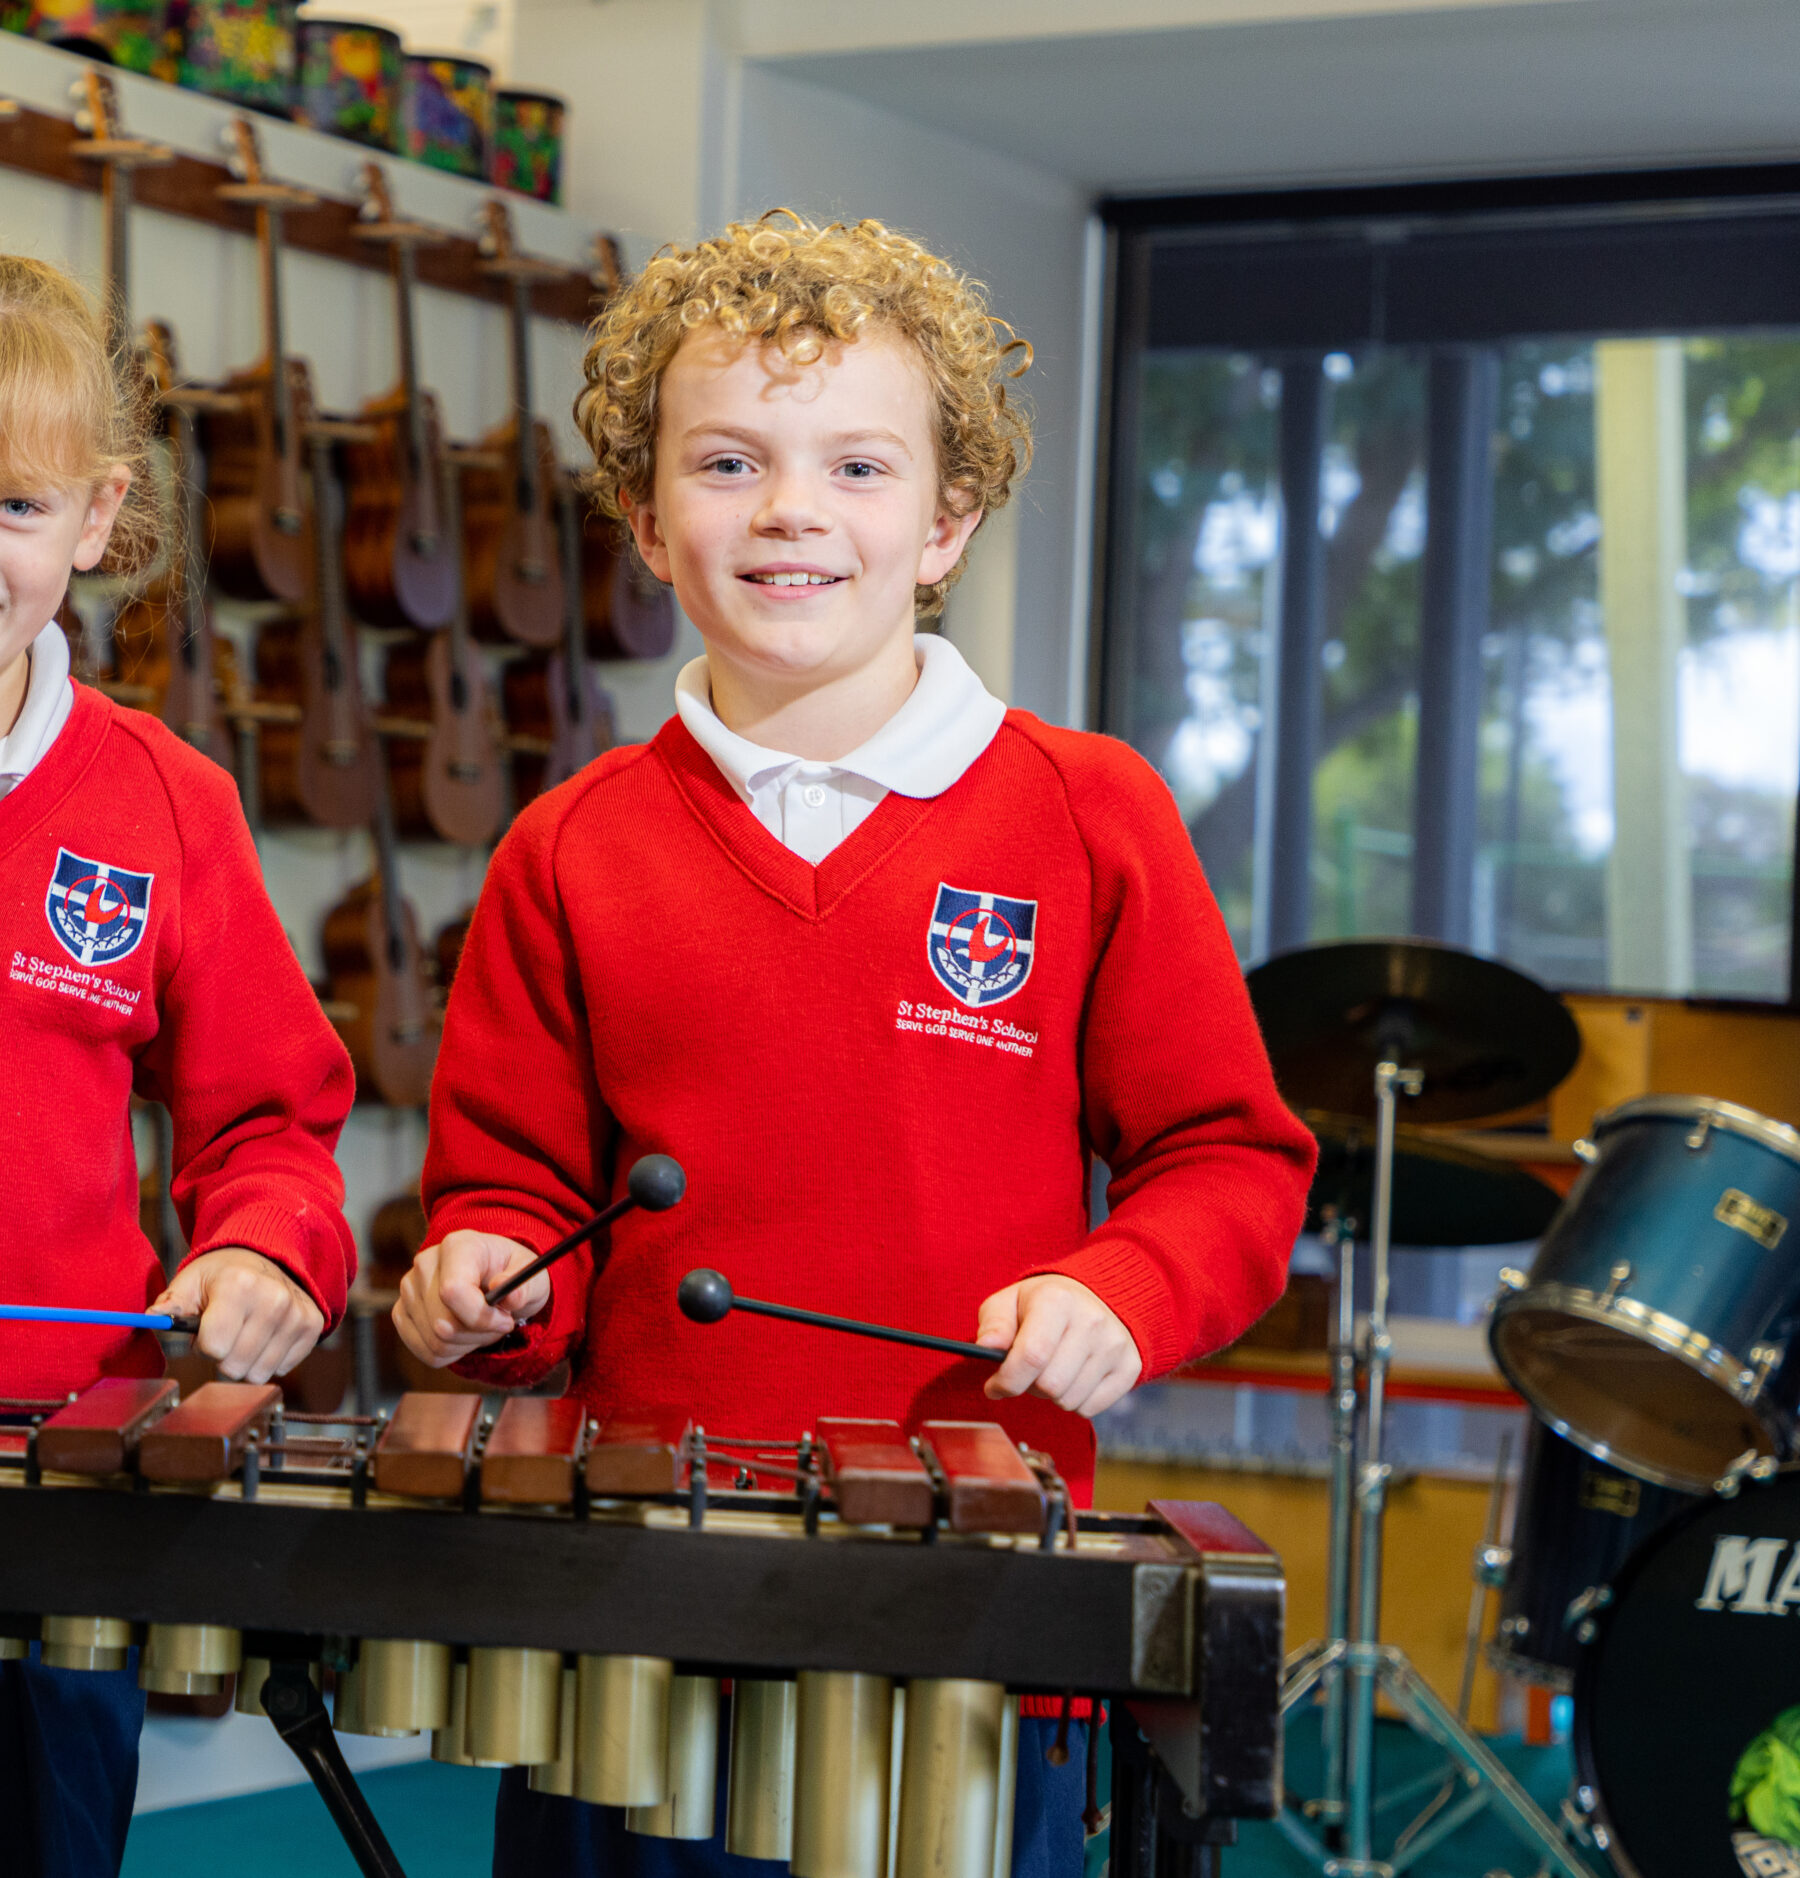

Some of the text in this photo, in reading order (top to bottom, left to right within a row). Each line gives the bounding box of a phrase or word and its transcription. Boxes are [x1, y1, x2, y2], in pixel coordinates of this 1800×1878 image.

[10, 968, 34, 984] SERVE
[35, 976, 57, 990] GOD
[58, 981, 87, 999] SERVE
[87, 992, 101, 1004] NE
[12, 951, 27, 967] St
[28, 956, 101, 989] Stephen's
[896, 1018, 1033, 1058] SERVE GOD SERVE ONE ANOTHER
[898, 1000, 1038, 1044] St Stephen's School
